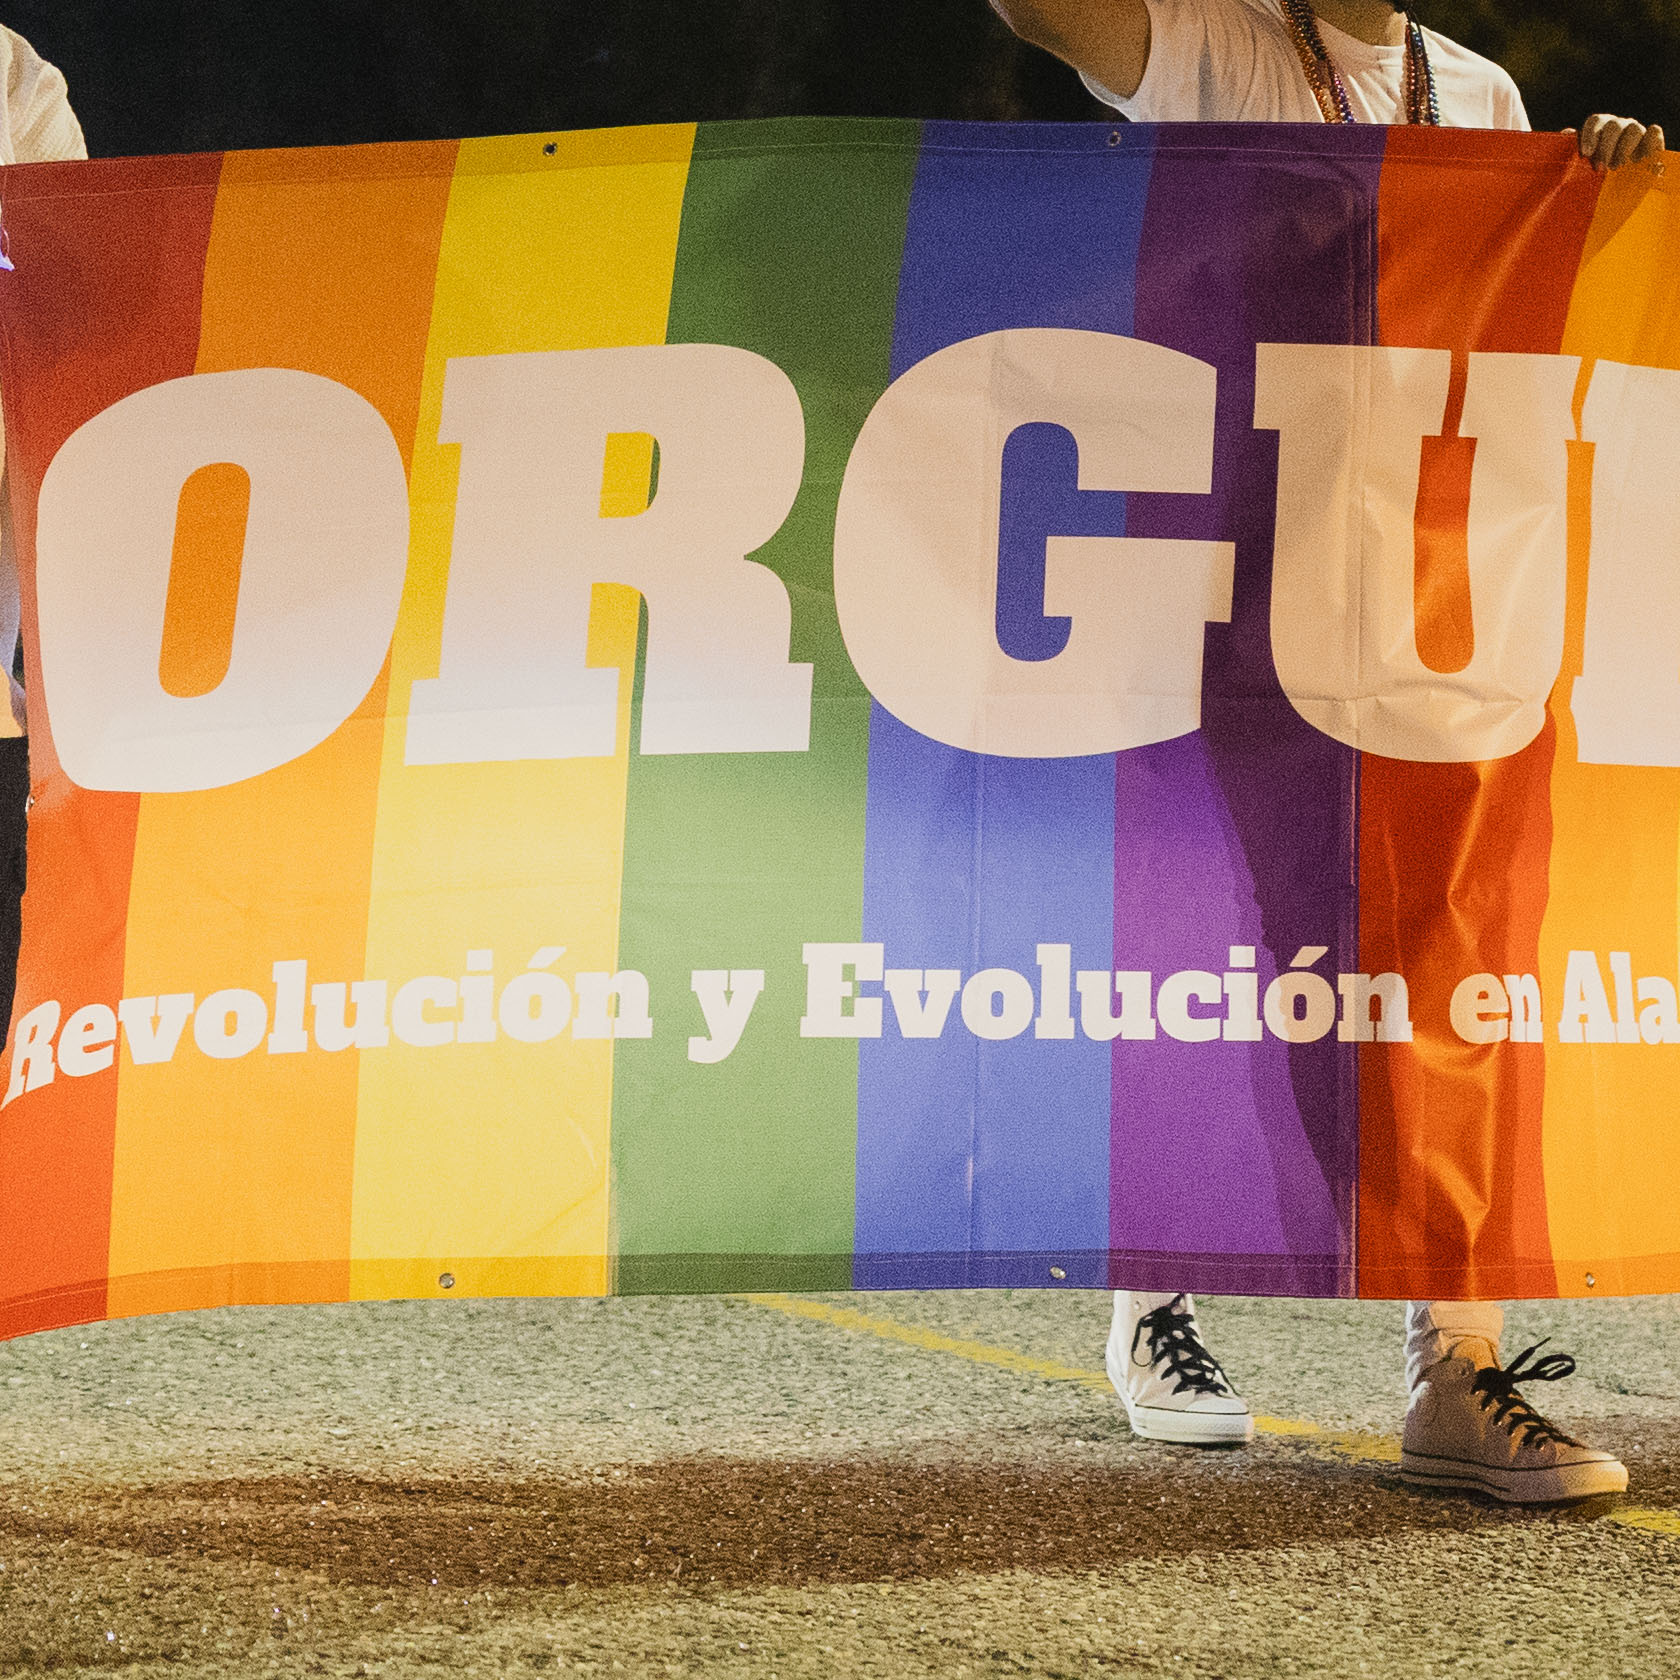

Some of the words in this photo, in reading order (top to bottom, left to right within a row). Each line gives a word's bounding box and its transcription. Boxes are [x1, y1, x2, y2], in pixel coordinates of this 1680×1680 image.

[0, 948, 652, 1109] Revolución
[687, 968, 766, 1064] y
[801, 943, 1413, 1042] Evolución
[1451, 968, 1543, 1043] en
